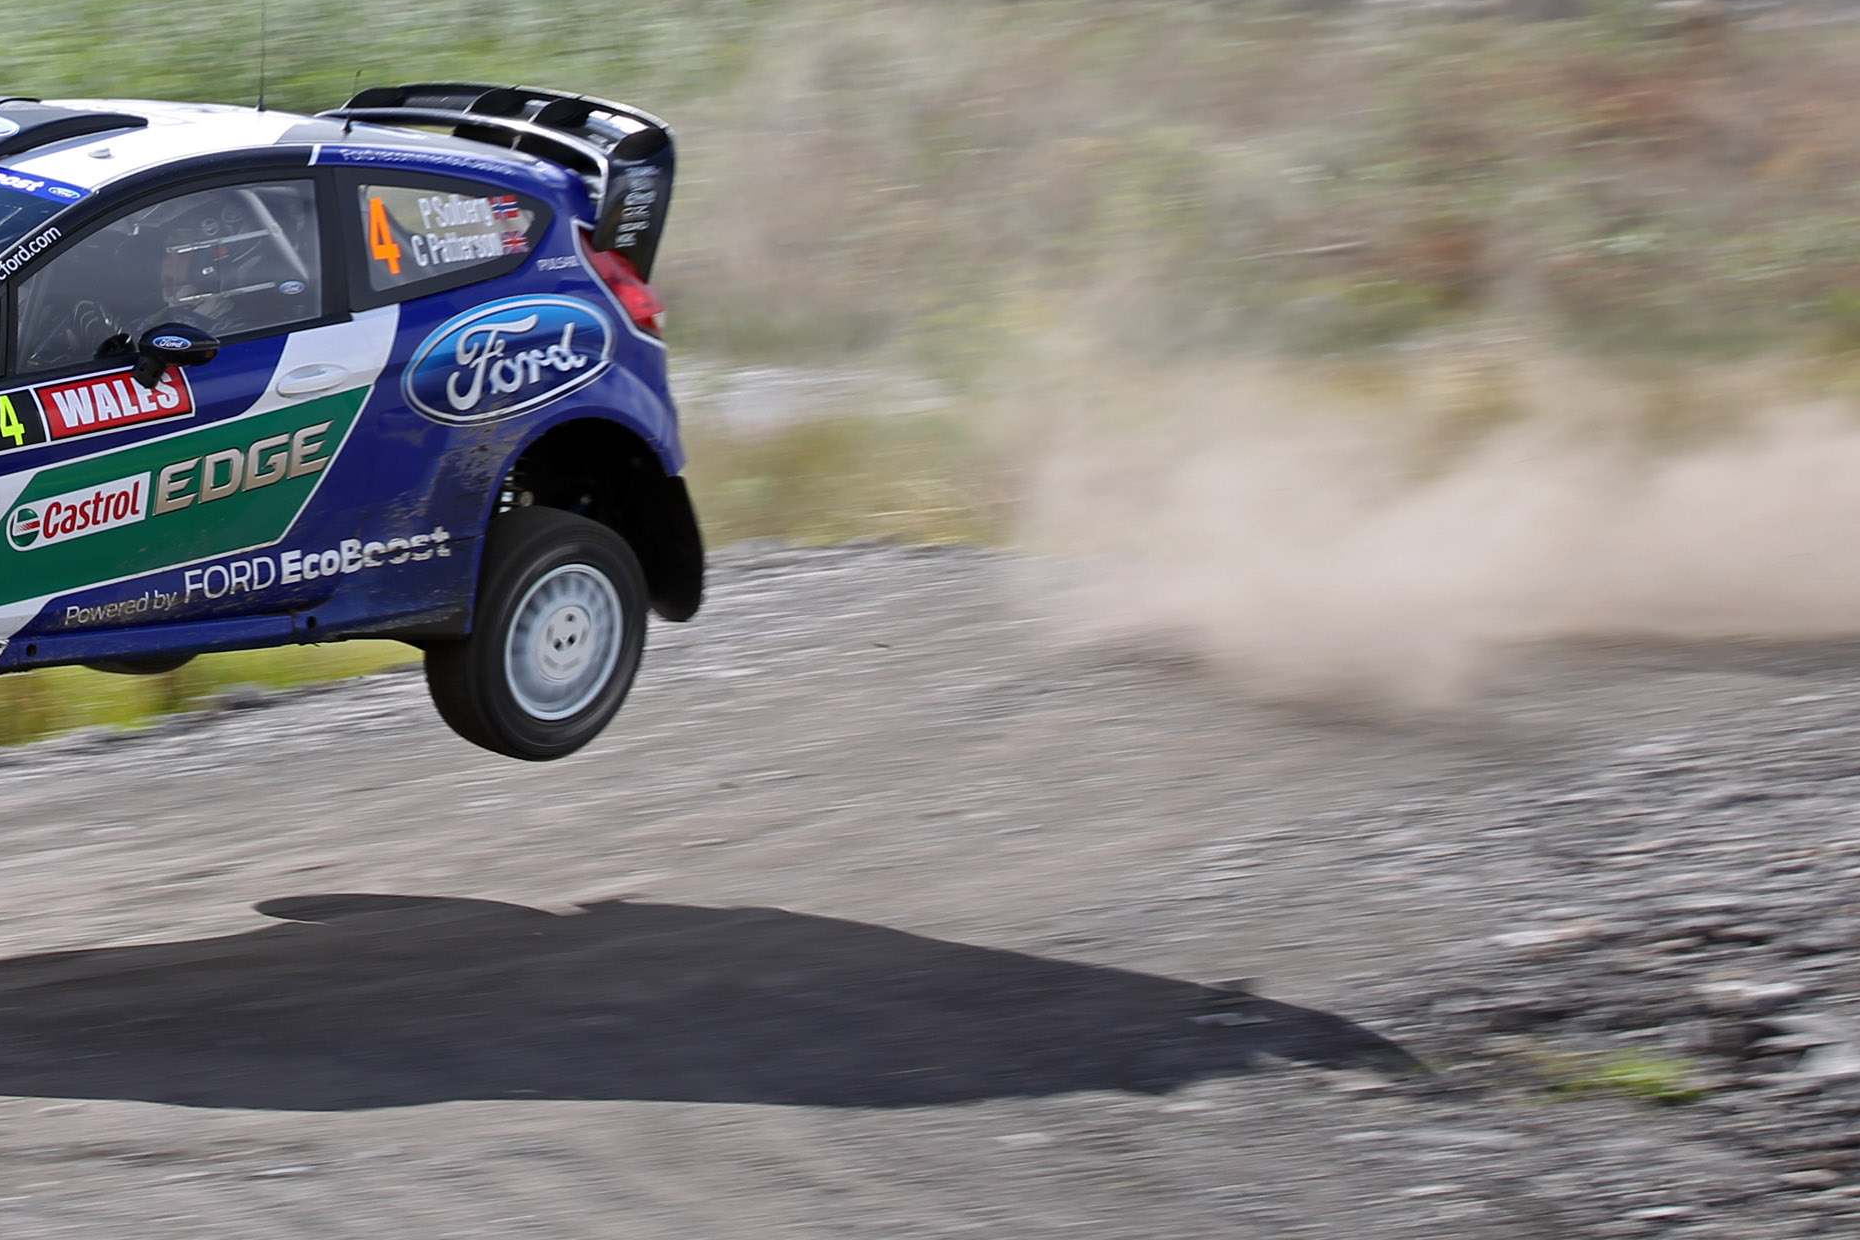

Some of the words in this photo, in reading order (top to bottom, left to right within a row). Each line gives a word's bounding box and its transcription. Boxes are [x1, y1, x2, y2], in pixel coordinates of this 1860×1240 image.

[369, 197, 402, 275] 4
[418, 197, 431, 229] P
[410, 234, 429, 267] C
[159, 339, 185, 349] Ford
[446, 313, 588, 412] Ford
[51, 372, 180, 428] WALES
[42, 481, 141, 540] Castrol
[152, 419, 334, 516] EDGE
[65, 591, 149, 626] Powered
[152, 592, 178, 613] by
[183, 559, 278, 605] FORD
[279, 525, 453, 585] EcoBoost
